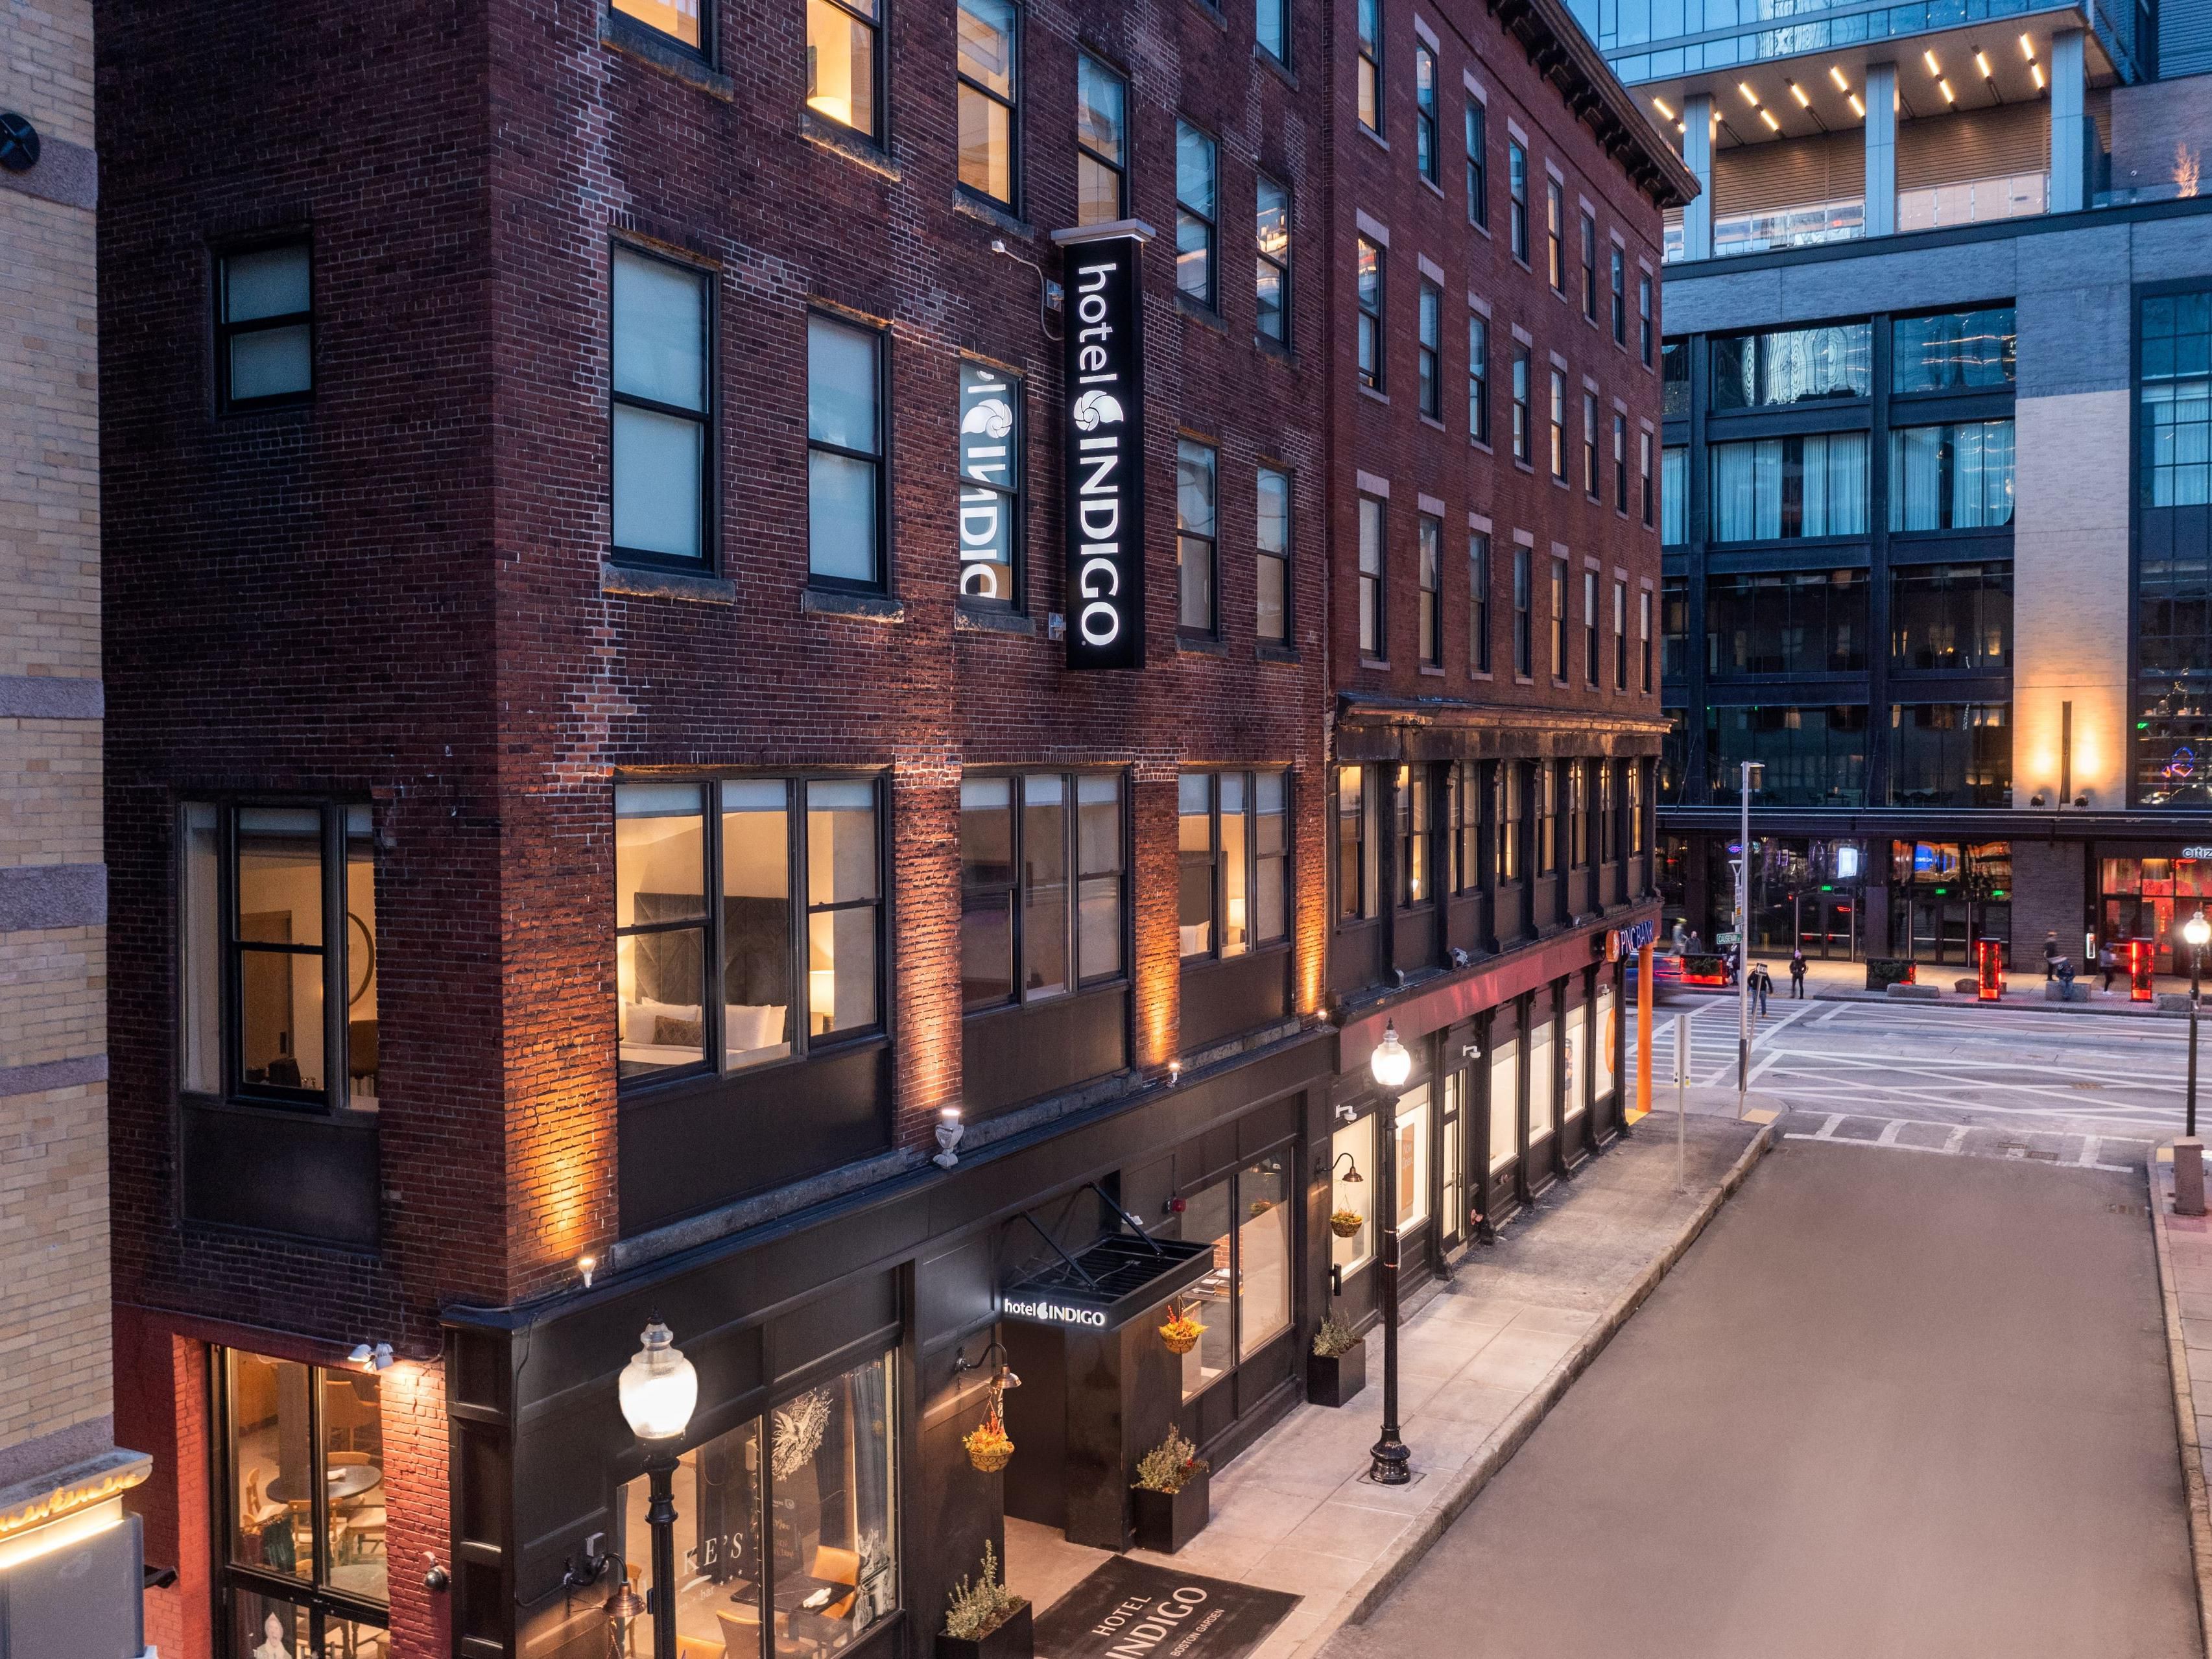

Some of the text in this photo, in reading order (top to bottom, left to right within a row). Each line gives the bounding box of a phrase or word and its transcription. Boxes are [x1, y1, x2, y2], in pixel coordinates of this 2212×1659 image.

[1078, 262, 1119, 646] hotel INDIGO
[1620, 920, 1654, 955] PNC BANK
[1718, 935, 1737, 943] CAUSEWAY
[1005, 1298, 1106, 1326] hotel INDIGO
[674, 1533, 743, 1581] KE'S
[1091, 1596, 1152, 1636] HOTEL
[1105, 1587, 1207, 1659] INDIGO
[1170, 1608, 1225, 1657] BOSTON GARDEN
